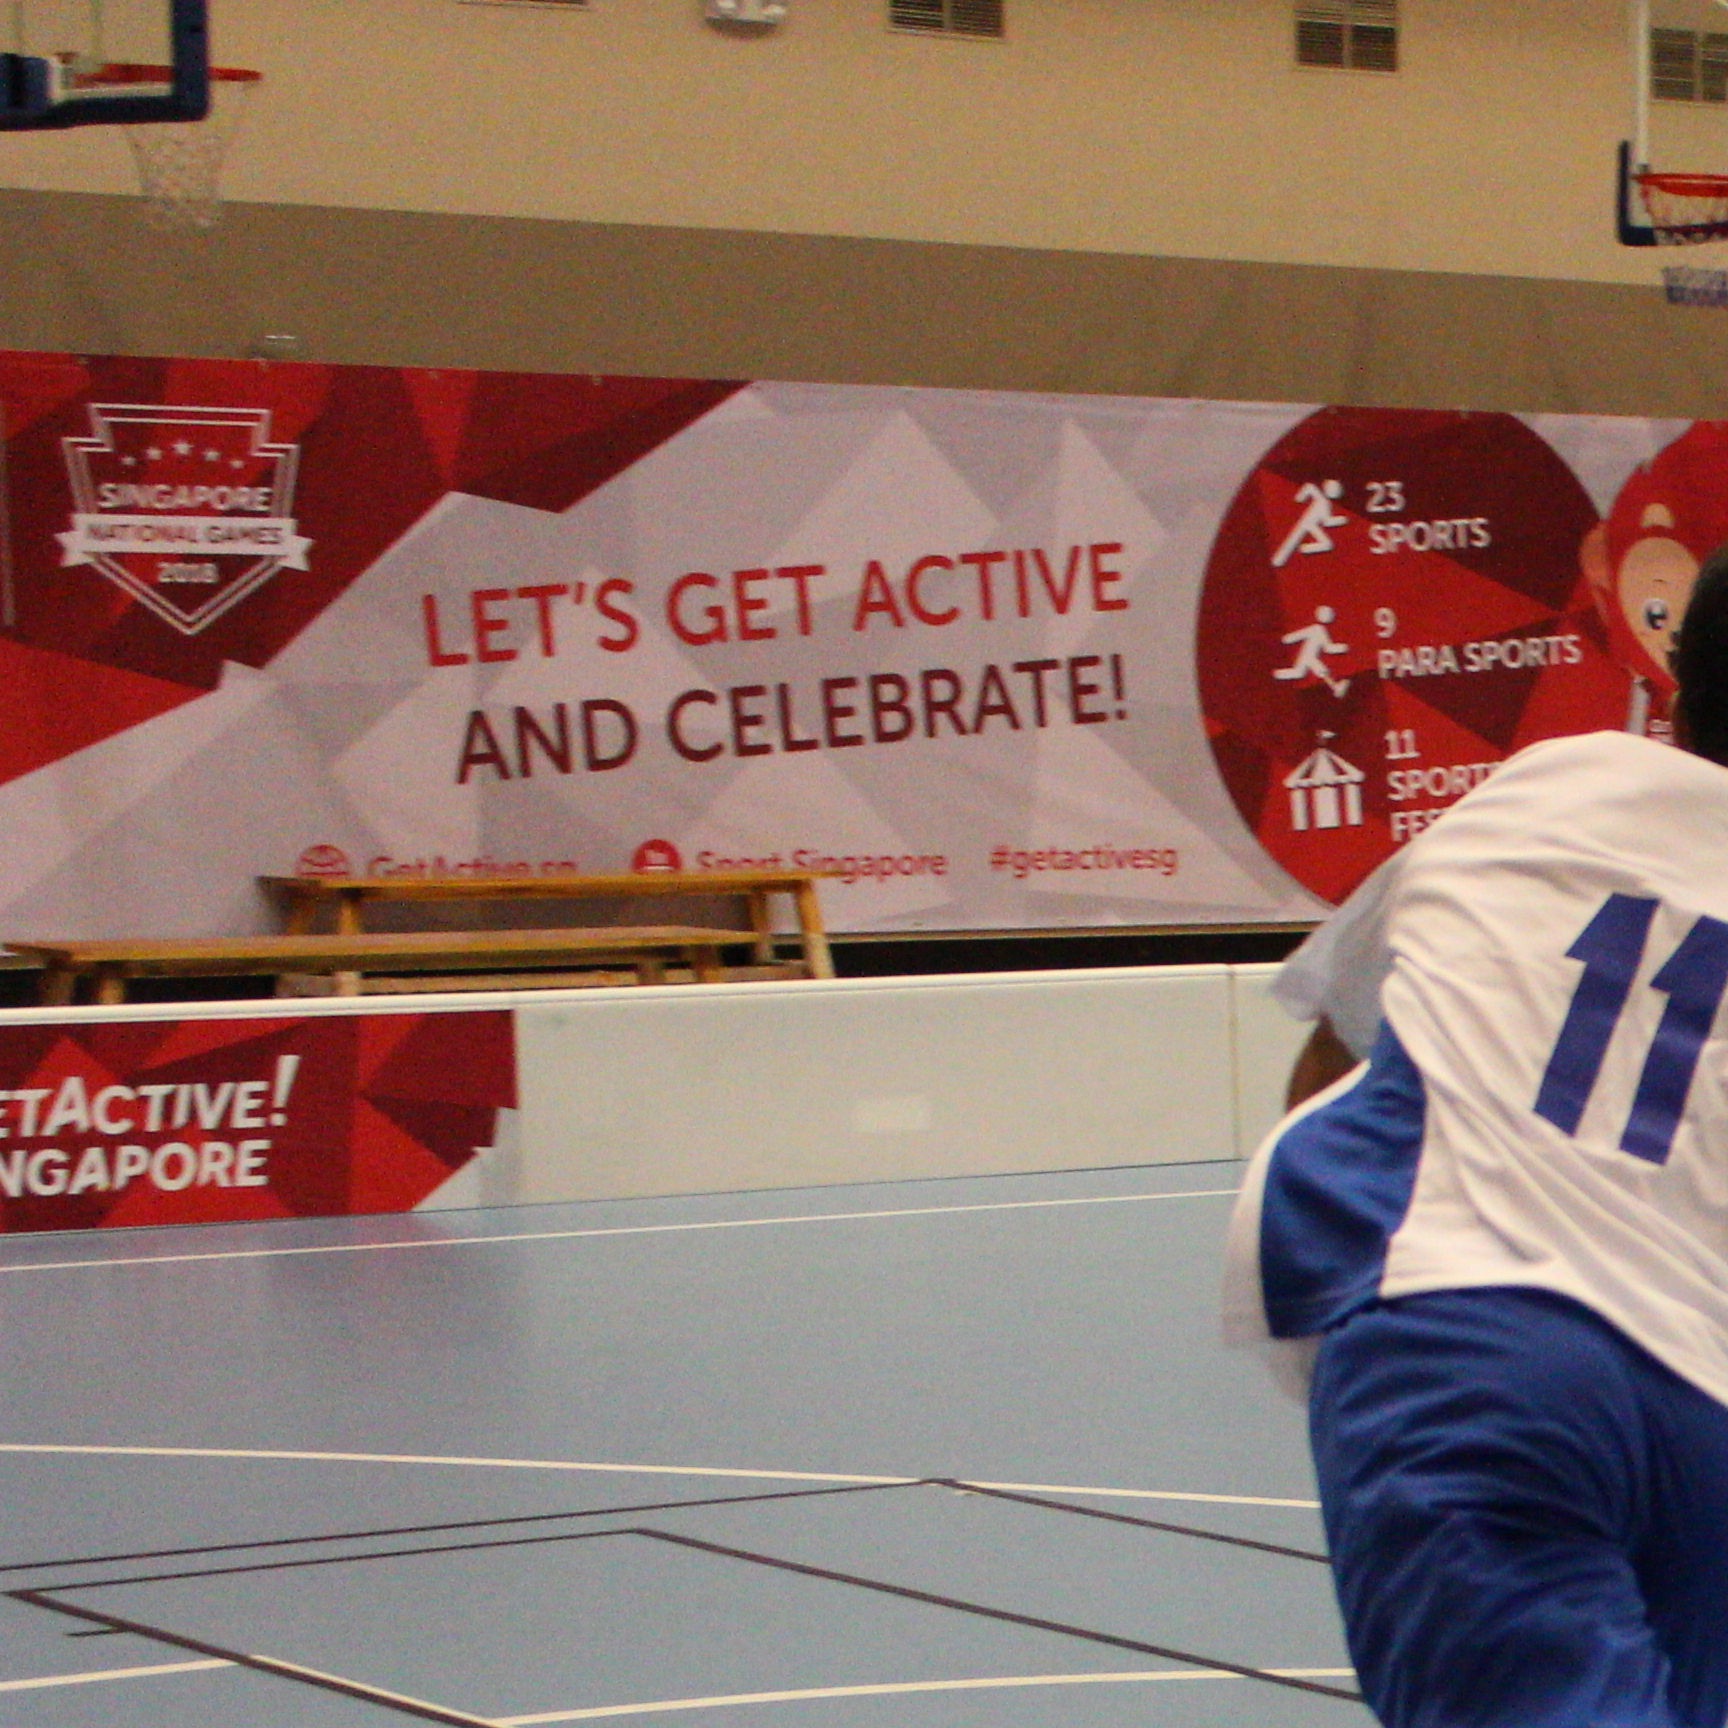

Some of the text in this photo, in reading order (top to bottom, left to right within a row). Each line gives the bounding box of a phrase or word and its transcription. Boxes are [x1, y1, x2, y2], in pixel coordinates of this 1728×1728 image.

[98, 483, 273, 512] SINGAPORE
[1365, 480, 1406, 513] 23
[88, 523, 283, 544] NATIONAL GAMES
[1368, 517, 1492, 555] SPORTS
[423, 542, 1130, 667] LET'S GET ACTIVE
[1373, 606, 1398, 639] 9
[1378, 634, 1584, 680] PARA SPORTS
[457, 653, 1129, 785] AND CELEBRATE!
[1384, 728, 1422, 760] 11
[1387, 761, 1501, 801] SPORT
[793, 848, 948, 885] Singapore
[990, 844, 1179, 879] #getactivesg
